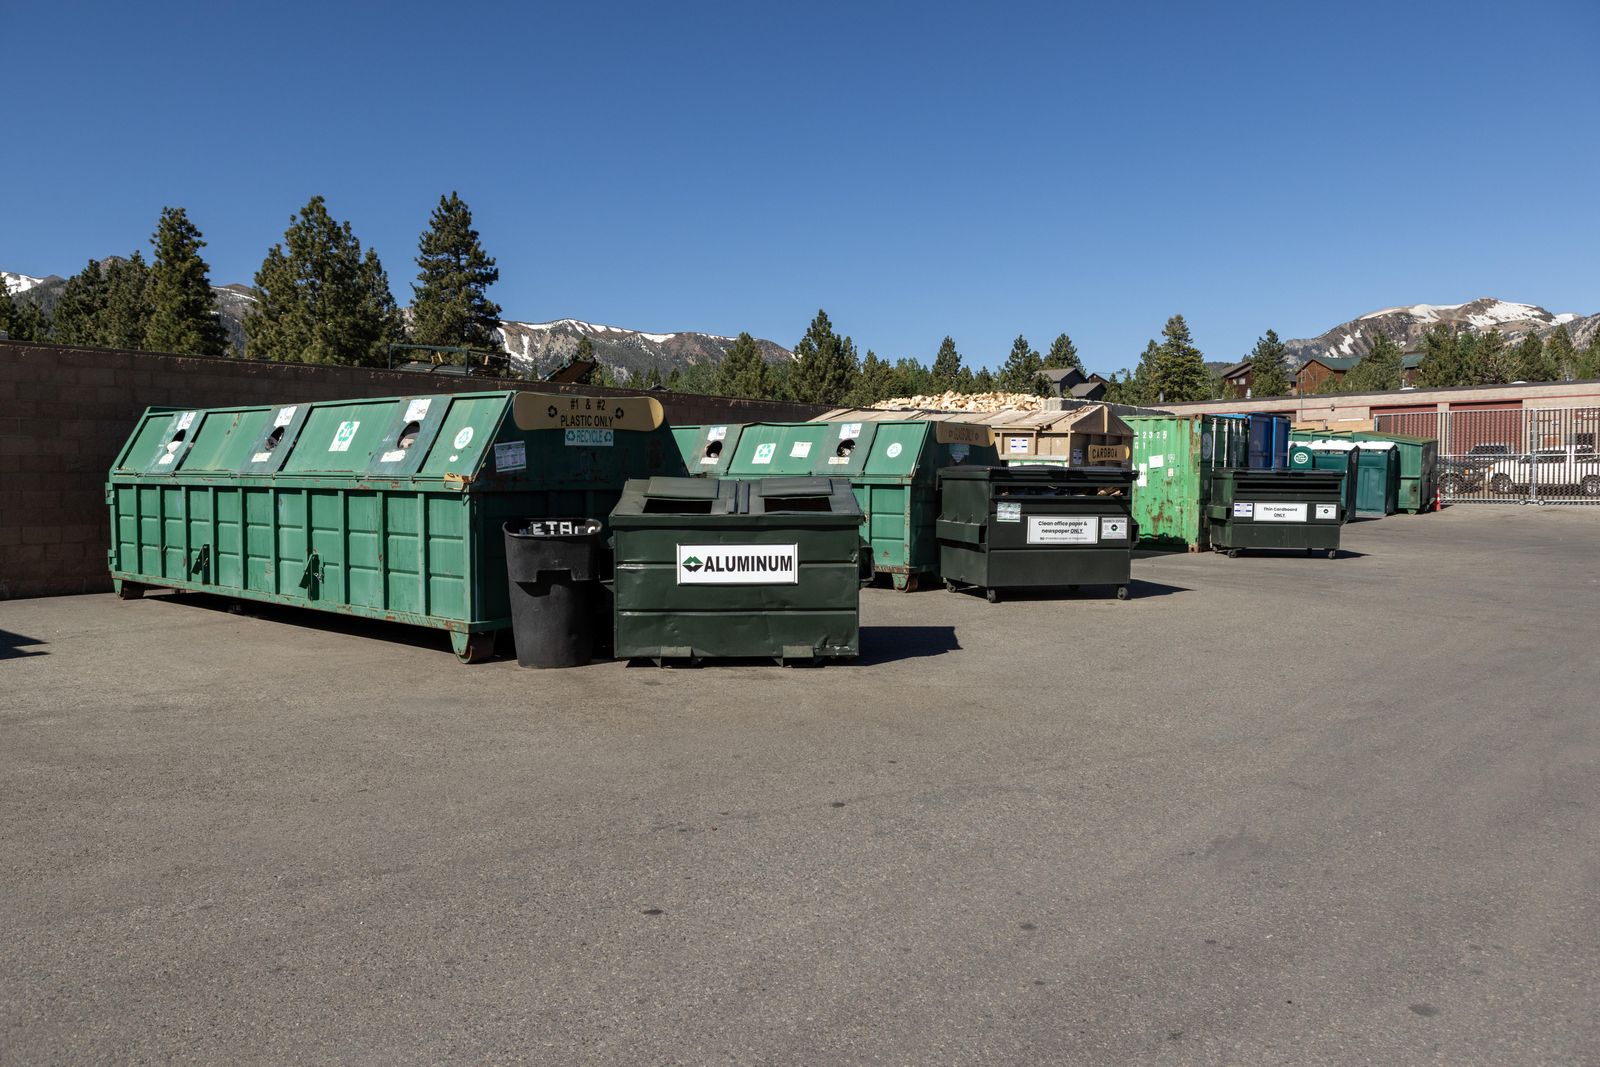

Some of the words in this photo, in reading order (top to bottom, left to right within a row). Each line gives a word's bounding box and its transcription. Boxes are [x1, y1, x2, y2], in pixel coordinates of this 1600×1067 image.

[570, 399, 579, 410] #1
[585, 399, 591, 410] &
[596, 399, 606, 411] #2
[560, 415, 592, 427] PLASTIC
[593, 415, 614, 427] ONLY
[576, 430, 603, 443] RECYCLE
[703, 555, 792, 572] ALUMINUM
